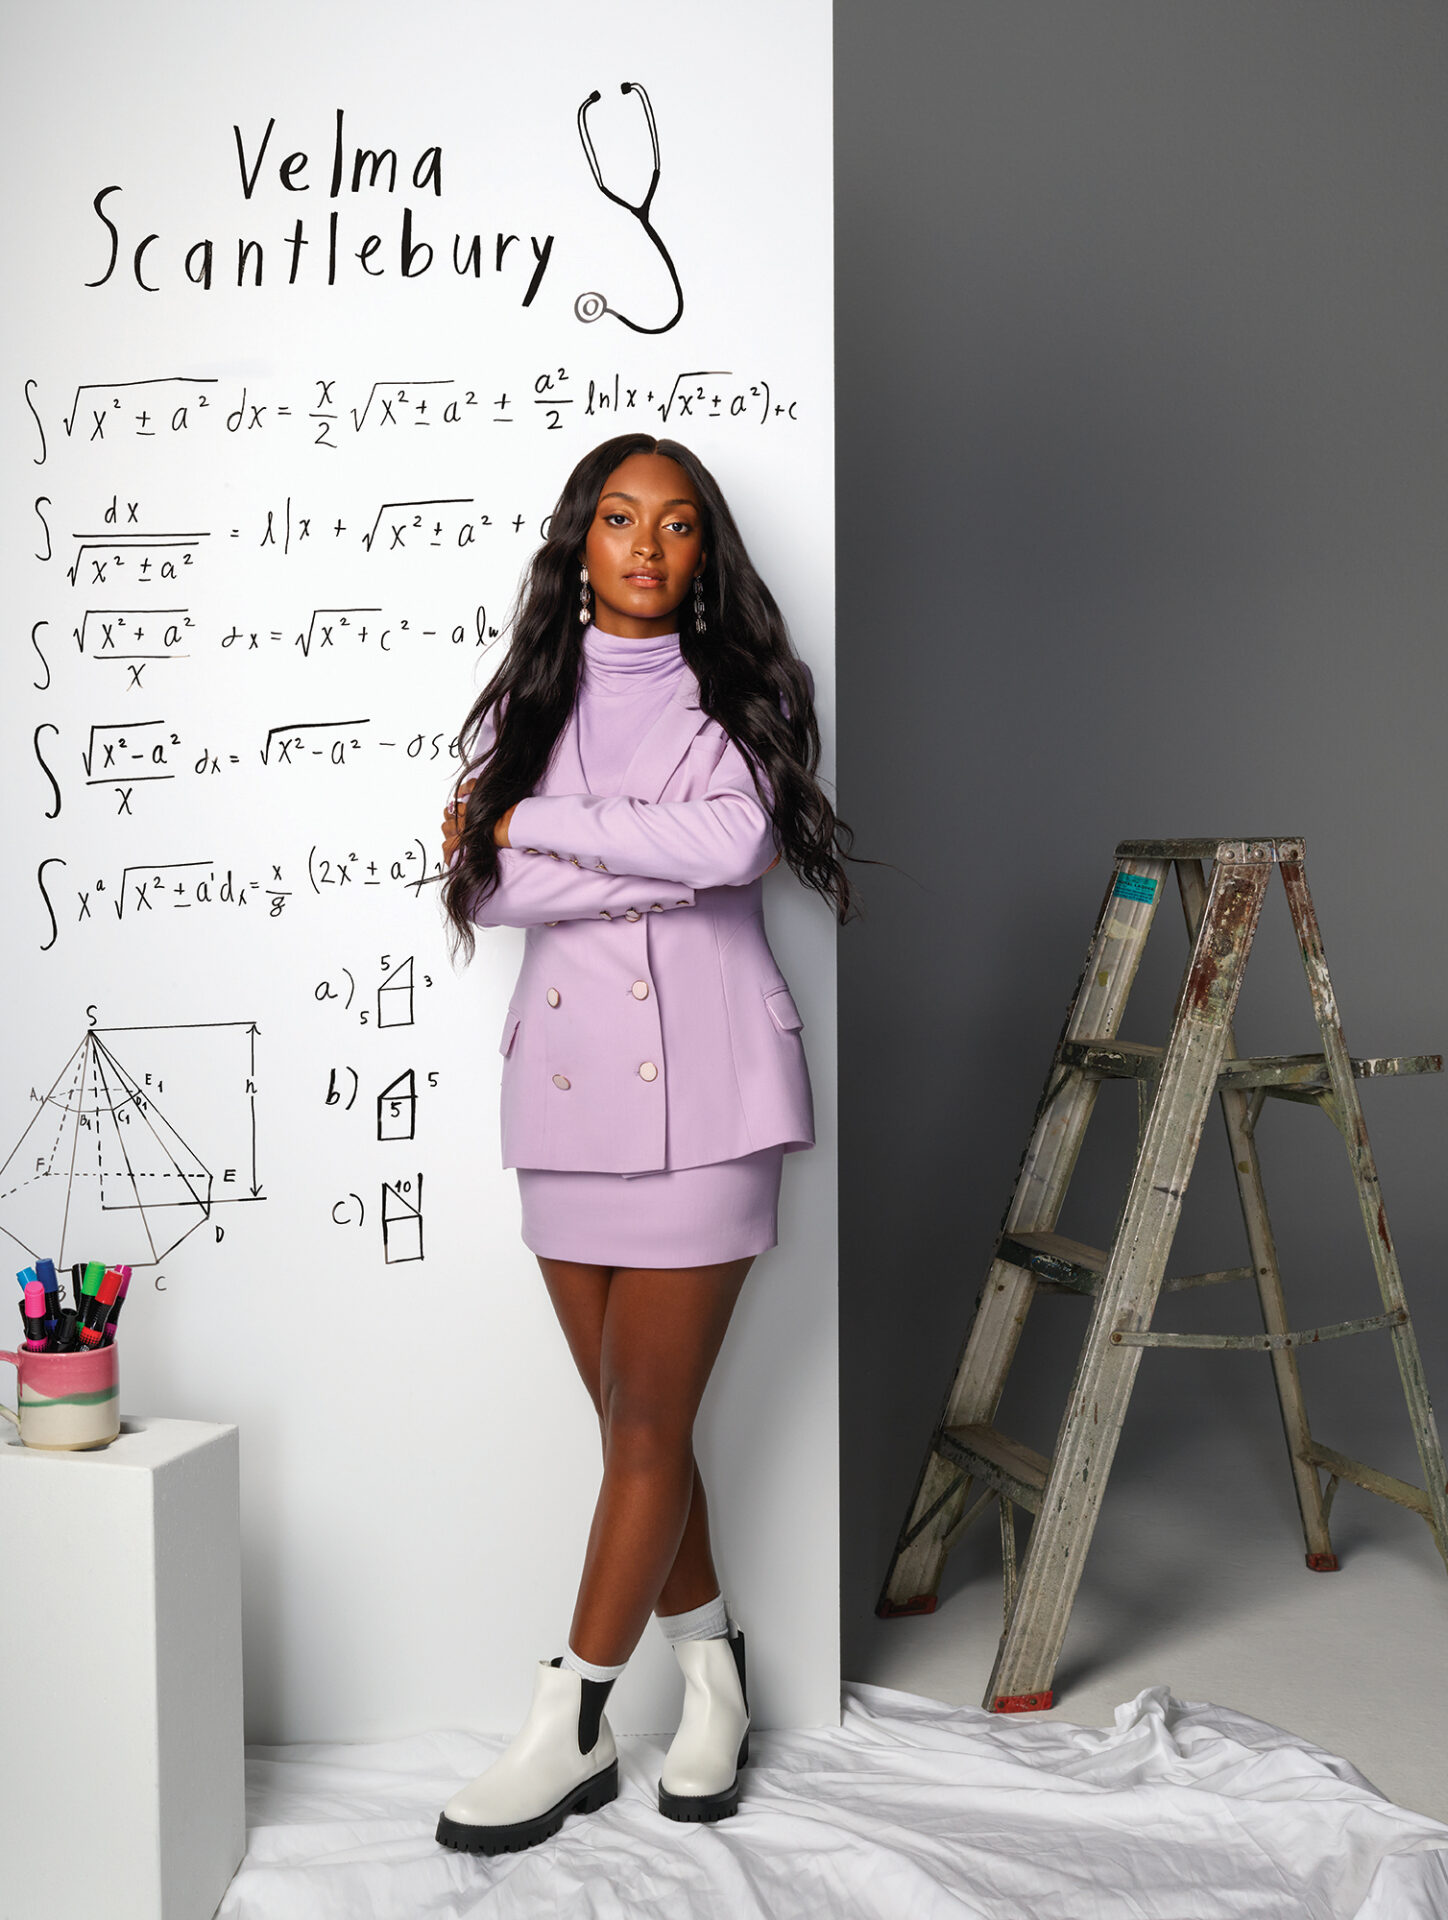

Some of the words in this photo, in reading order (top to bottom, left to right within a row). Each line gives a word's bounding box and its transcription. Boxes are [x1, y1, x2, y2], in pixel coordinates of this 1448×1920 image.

[232, 108, 443, 200] Velma
[84, 185, 555, 308] Scantlebury
[226, 387, 267, 433] dx
[545, 410, 563, 430] 2
[380, 954, 391, 972] 5
[423, 975, 433, 988] 3
[85, 1004, 98, 1027] S
[359, 1010, 370, 1026] 5
[427, 1071, 440, 1088] 5
[390, 1101, 403, 1118] 5
[35, 1157, 45, 1172] F
[223, 1168, 237, 1183] E
[394, 1179, 412, 1193] 10
[215, 1225, 225, 1244] D
